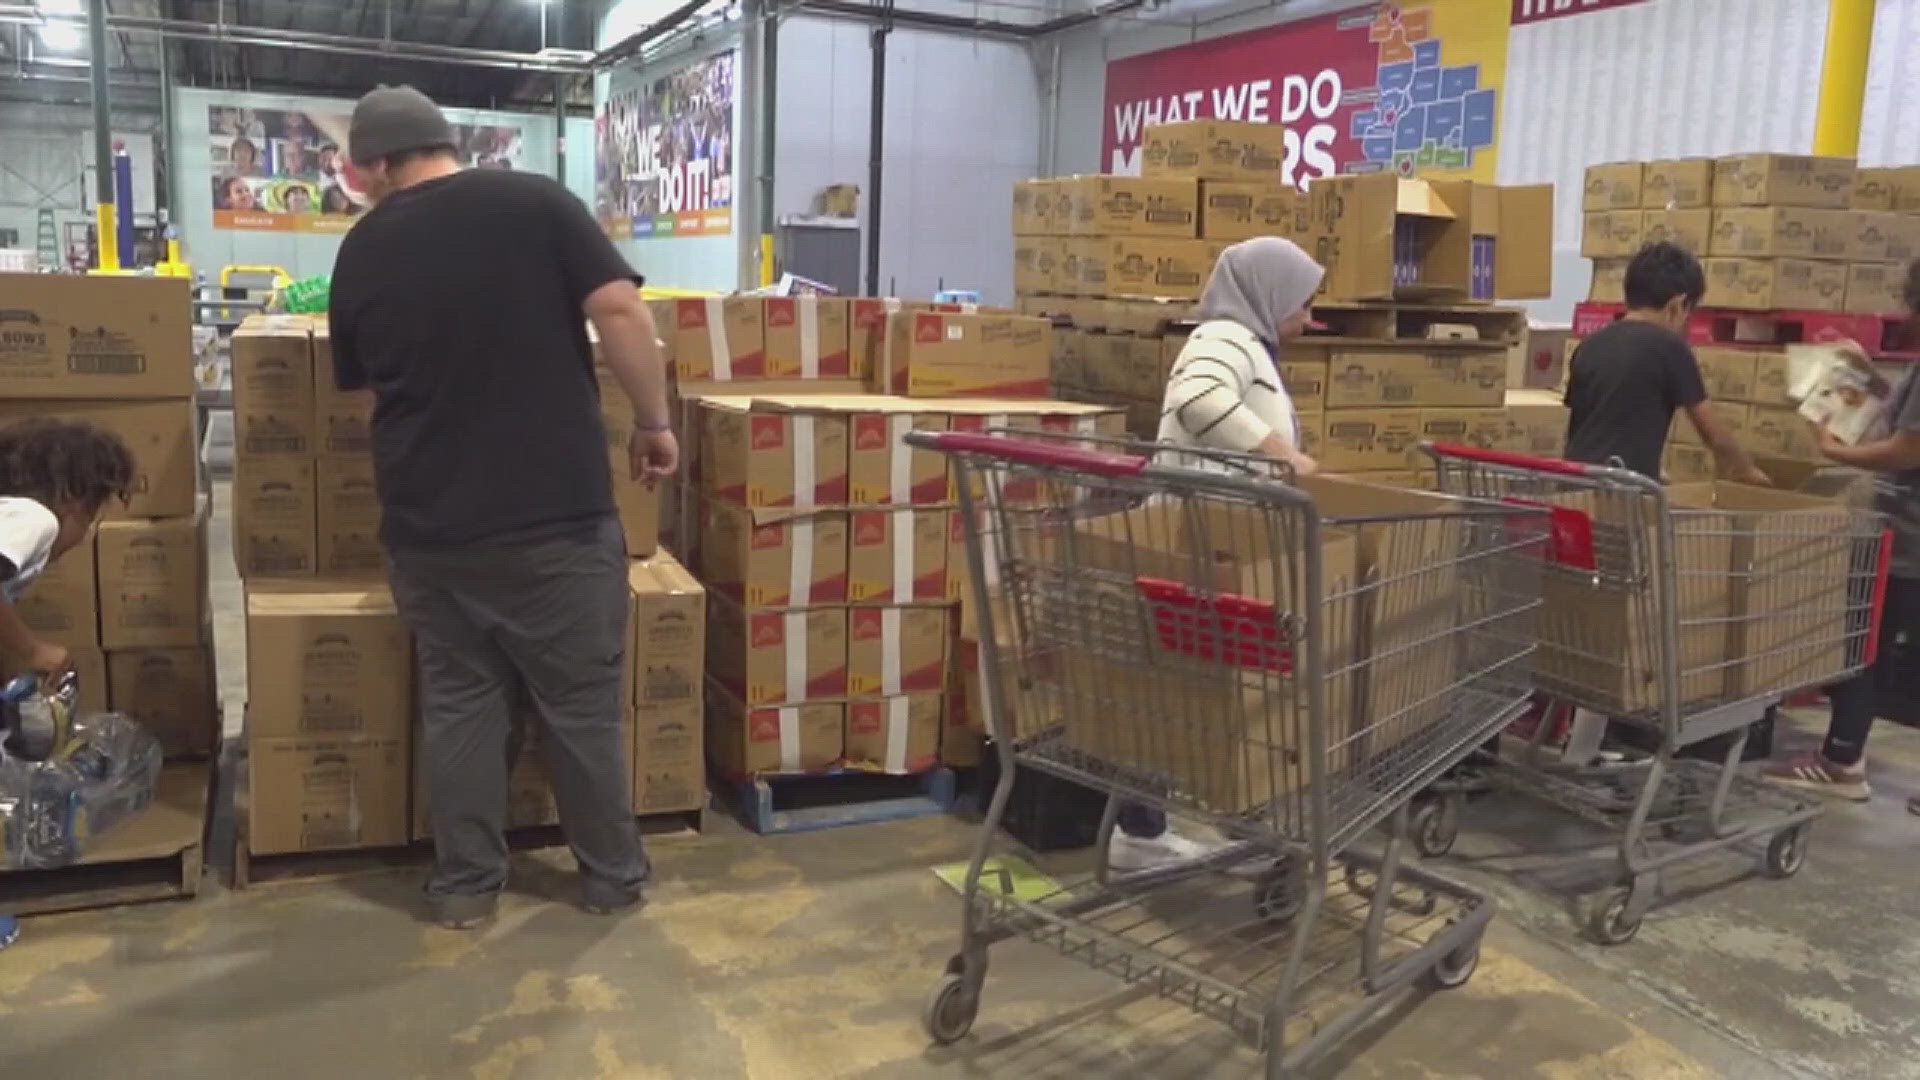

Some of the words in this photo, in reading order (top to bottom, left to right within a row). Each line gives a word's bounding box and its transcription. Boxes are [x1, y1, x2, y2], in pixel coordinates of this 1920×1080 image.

[1114, 90, 1204, 144] WHAT
[1212, 79, 1272, 124] WE
[1281, 68, 1341, 124] DO
[638, 124, 662, 175] WE
[657, 165, 684, 214] DO
[686, 158, 710, 212] IT!
